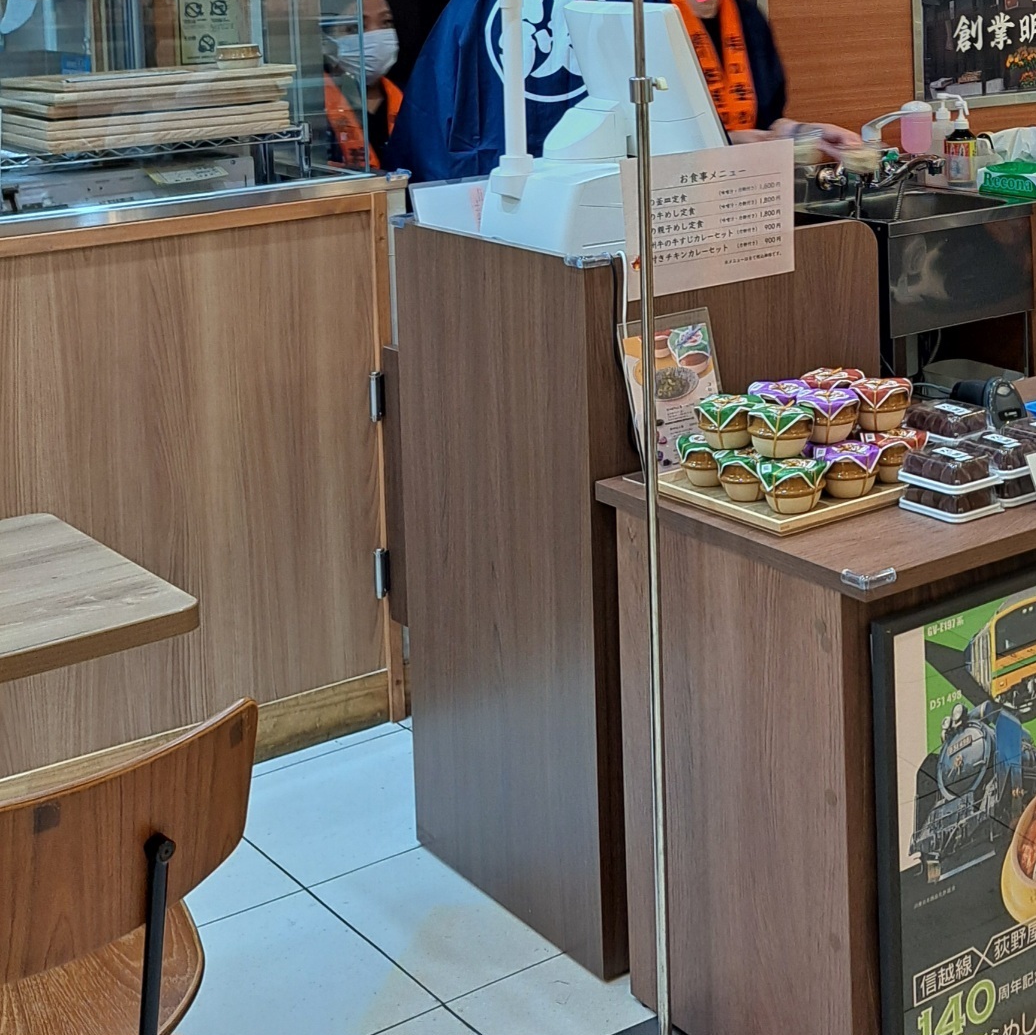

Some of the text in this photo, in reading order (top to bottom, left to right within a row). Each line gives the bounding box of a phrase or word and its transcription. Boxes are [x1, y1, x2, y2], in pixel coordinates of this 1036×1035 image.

[680, 169, 747, 184] お食事メニュー
[983, 172, 1034, 192] Recona
[651, 207, 696, 221] の牛めし定食
[651, 220, 704, 235] の親子めし定食
[920, 954, 973, 999] 信越線
